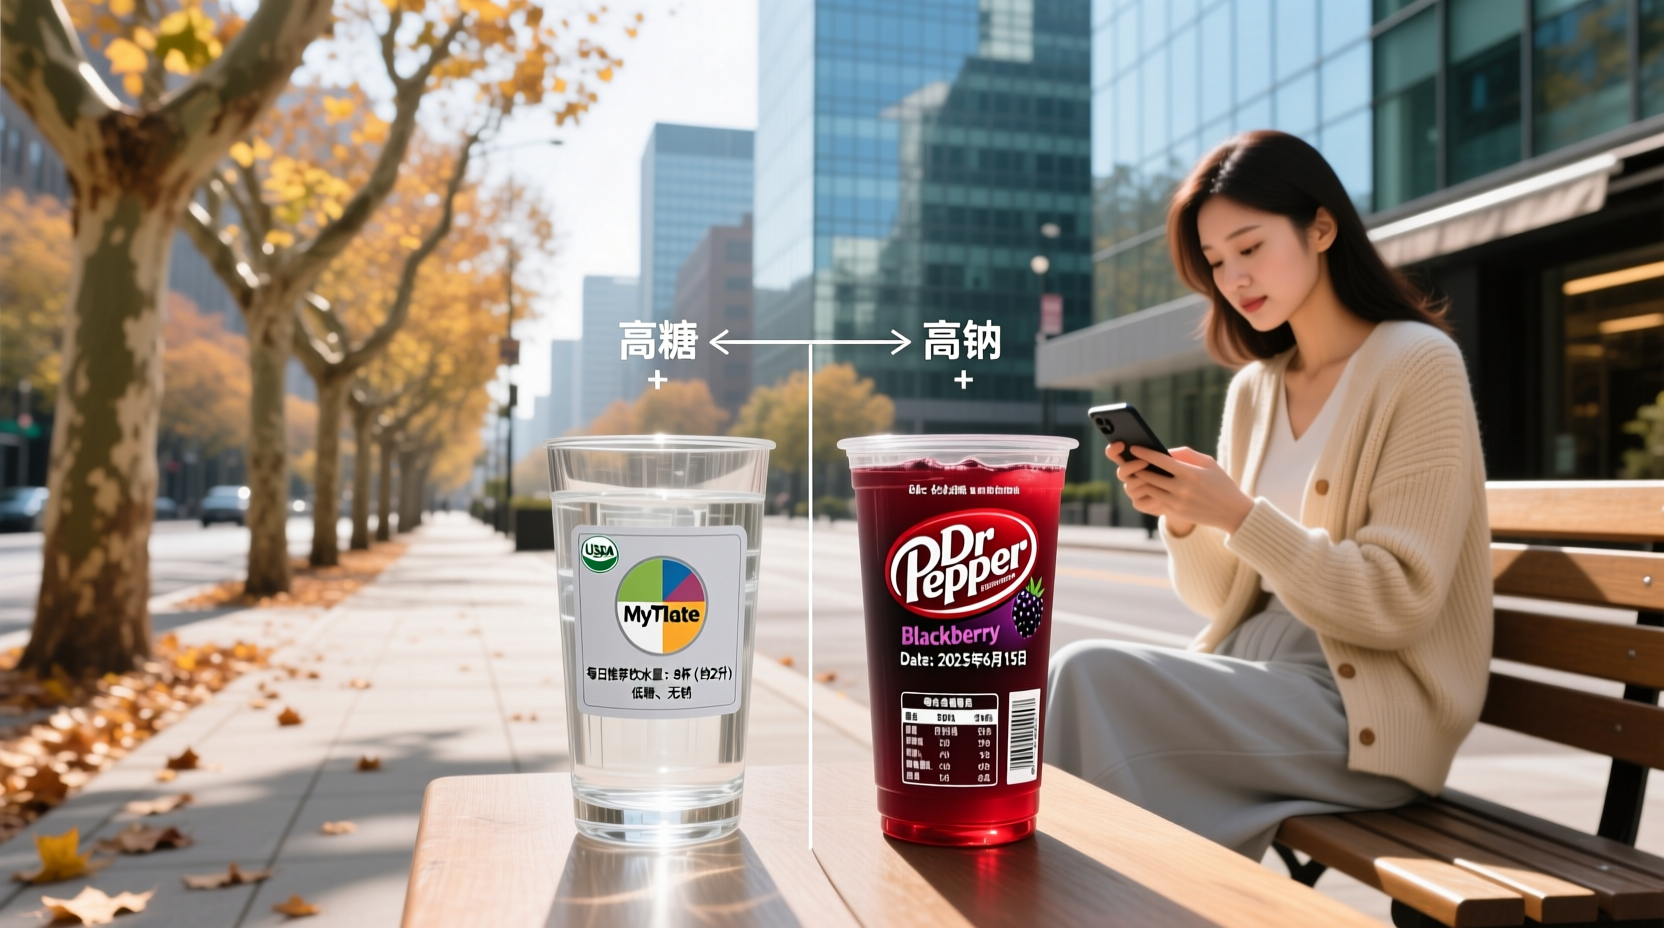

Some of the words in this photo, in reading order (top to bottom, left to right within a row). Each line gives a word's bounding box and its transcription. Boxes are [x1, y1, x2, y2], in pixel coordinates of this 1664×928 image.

[940, 524, 995, 567] Dr
[890, 535, 1028, 606] Pepper
[901, 625, 1000, 646] Blackberry
